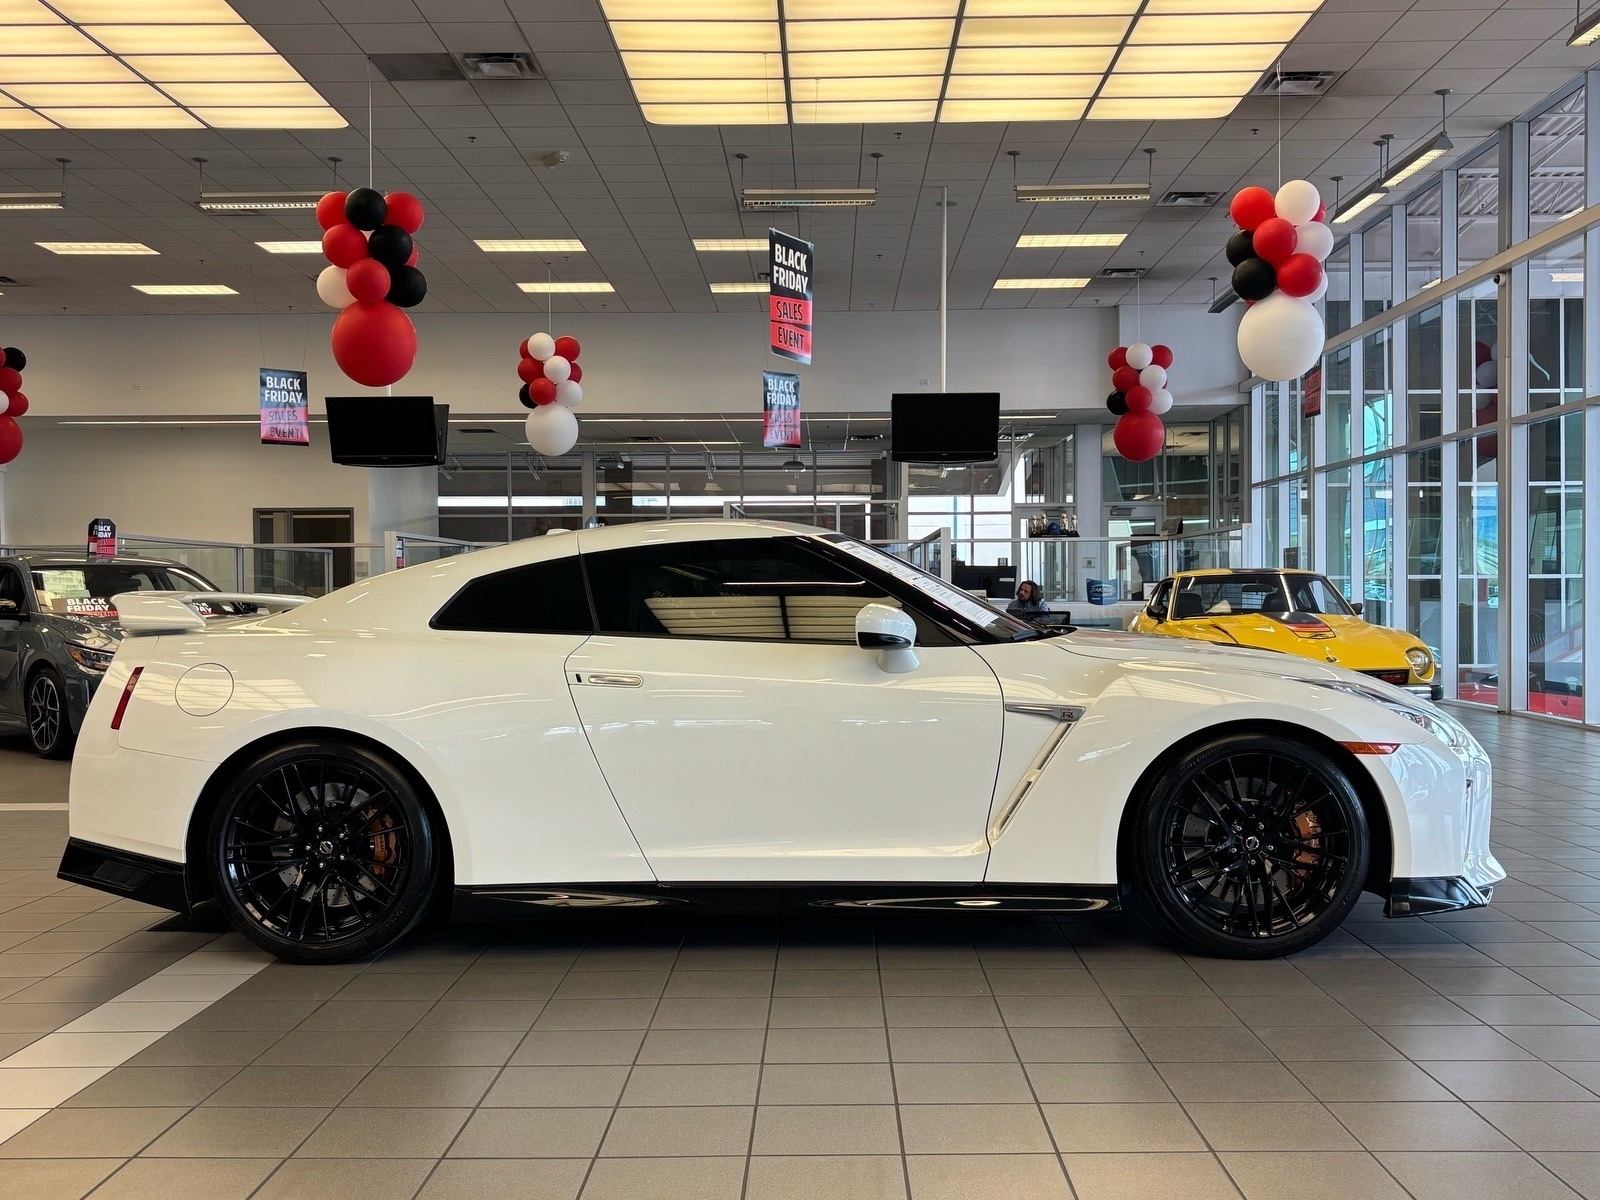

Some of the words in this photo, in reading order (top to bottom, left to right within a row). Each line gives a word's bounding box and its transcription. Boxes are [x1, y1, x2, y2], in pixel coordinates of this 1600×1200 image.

[775, 243, 807, 273] BLACK
[773, 265, 809, 294] FRIDAY
[776, 300, 803, 321] SALES
[777, 326, 805, 351] EVENT
[266, 376, 301, 390] BLACK
[768, 378, 795, 393] BLACK
[264, 390, 303, 403] FRIDAY
[766, 392, 797, 406] FRIDAY
[268, 410, 298, 422] SALES
[769, 412, 793, 424] SALES
[269, 426, 300, 439] EVENT
[770, 427, 795, 441] EVENT
[66, 598, 107, 606] BLACK
[66, 604, 110, 612] FRIDAY
